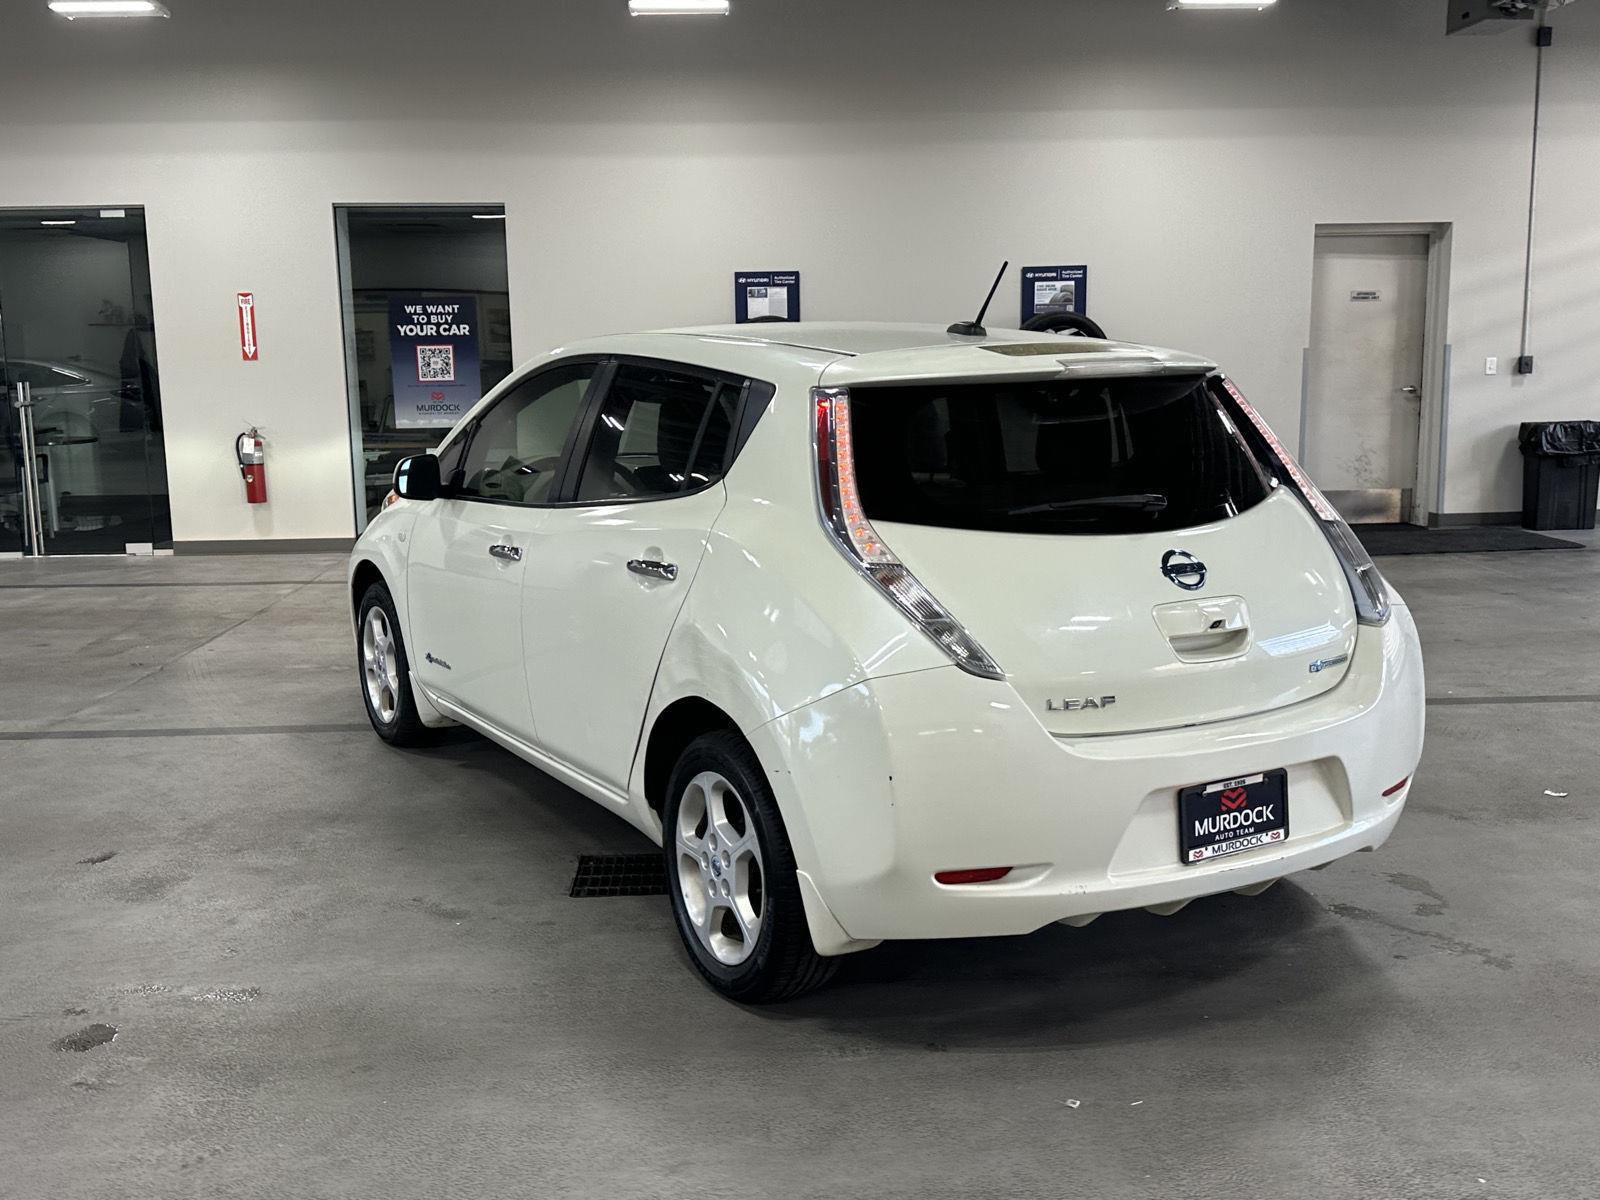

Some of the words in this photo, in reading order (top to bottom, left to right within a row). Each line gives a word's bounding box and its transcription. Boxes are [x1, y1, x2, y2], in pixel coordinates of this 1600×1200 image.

[404, 305, 423, 314] WE
[426, 305, 459, 314] WANT
[412, 315, 427, 323] TO
[430, 315, 453, 323] BUY
[397, 325, 437, 336] YOUR
[439, 324, 470, 336] CAR
[416, 403, 461, 412] MURDOCK
[1046, 695, 1116, 711] LEAF
[1194, 804, 1275, 837] MURDOCK
[1214, 831, 1234, 842] AUTO
[1236, 827, 1255, 837] TEAM
[1212, 835, 1263, 855] MURDOCK
